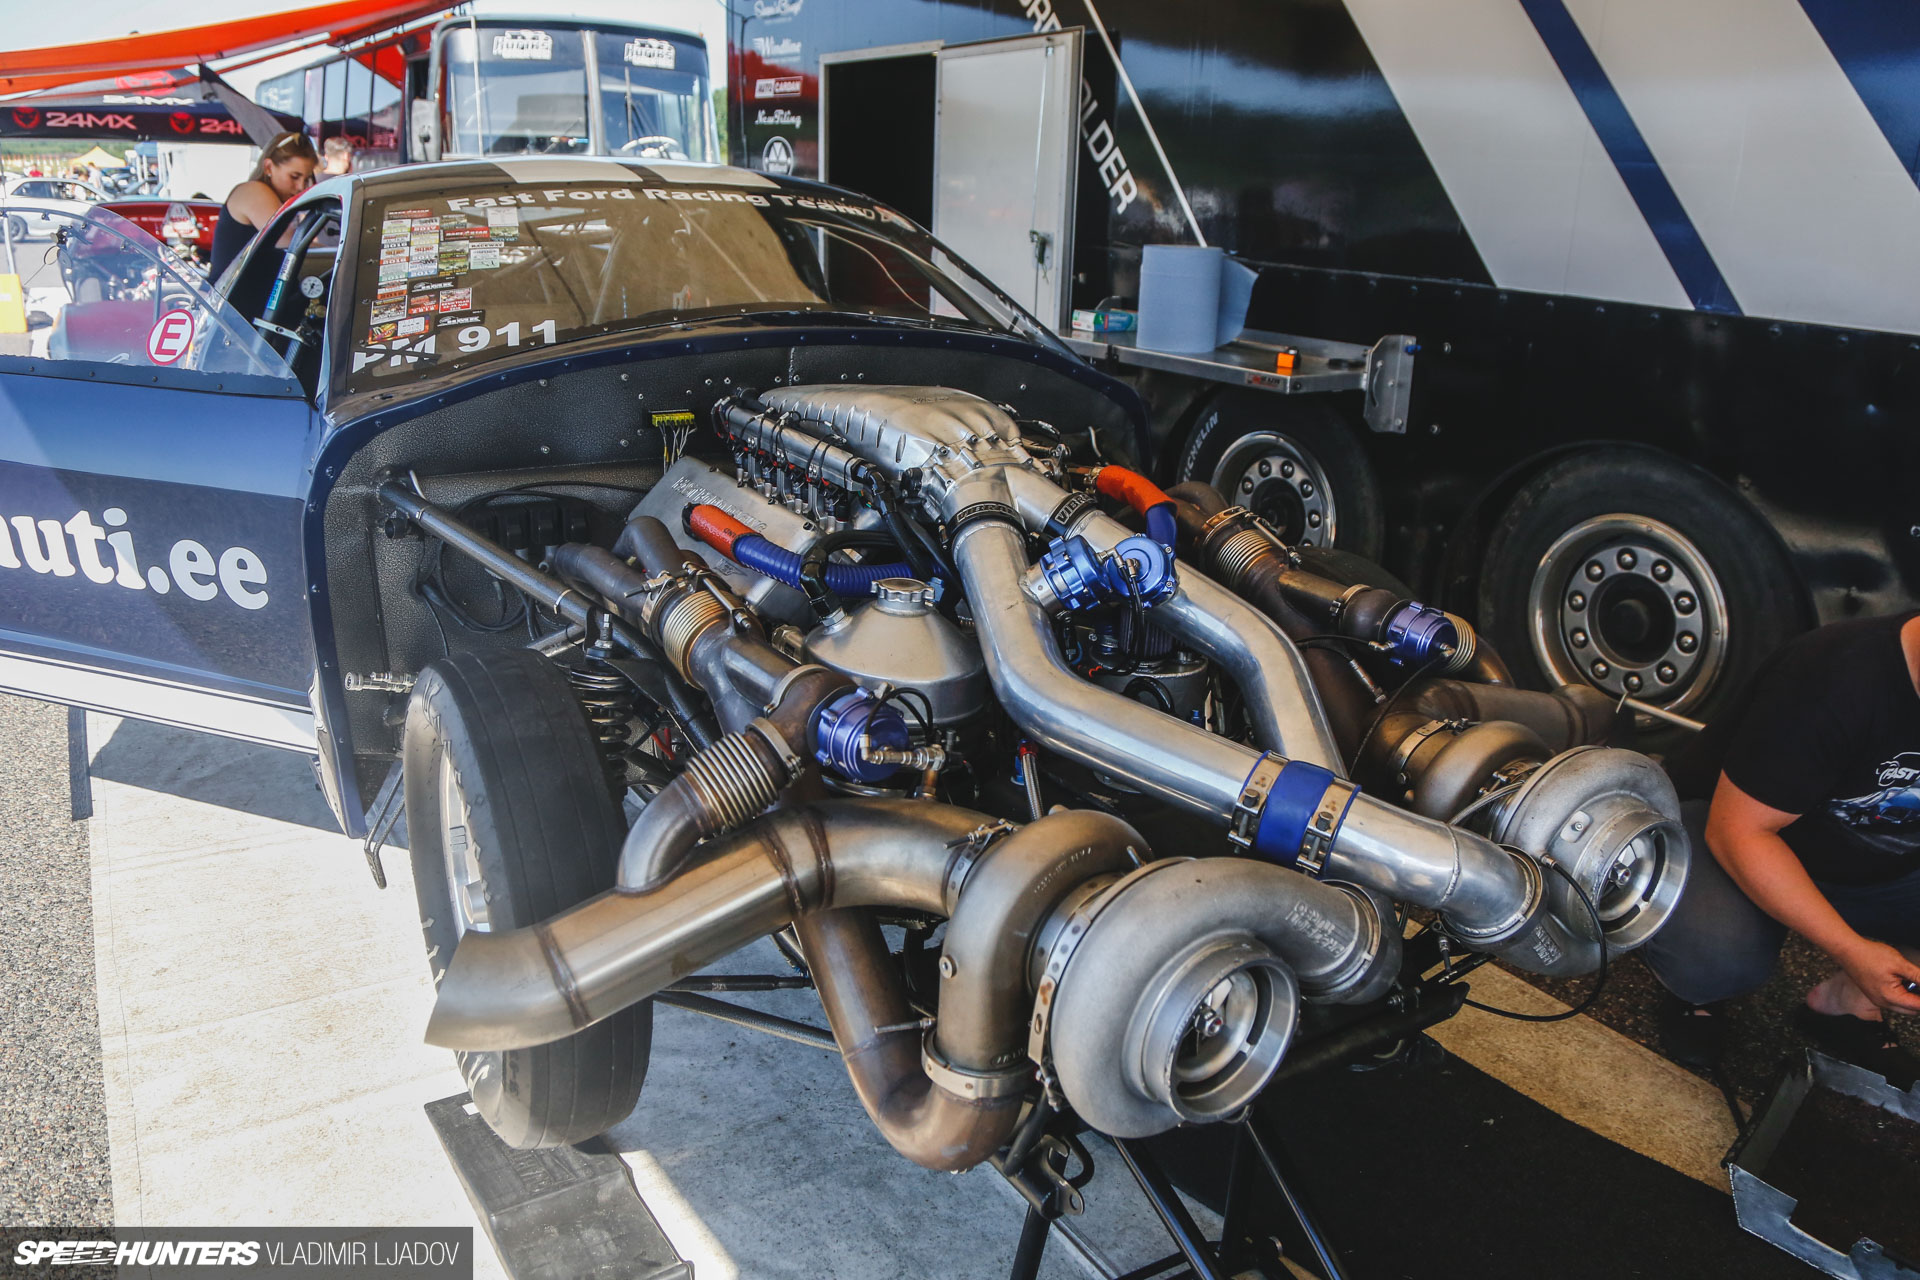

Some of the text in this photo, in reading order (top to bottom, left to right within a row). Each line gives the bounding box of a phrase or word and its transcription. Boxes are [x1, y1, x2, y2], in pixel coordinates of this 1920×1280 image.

[46, 111, 137, 130] 24MX
[447, 188, 867, 218] Fast Ford Racing Team
[154, 318, 188, 356] E
[457, 319, 557, 353] 911
[0, 506, 270, 611] uti.ee
[1882, 767, 1920, 781] FAST
